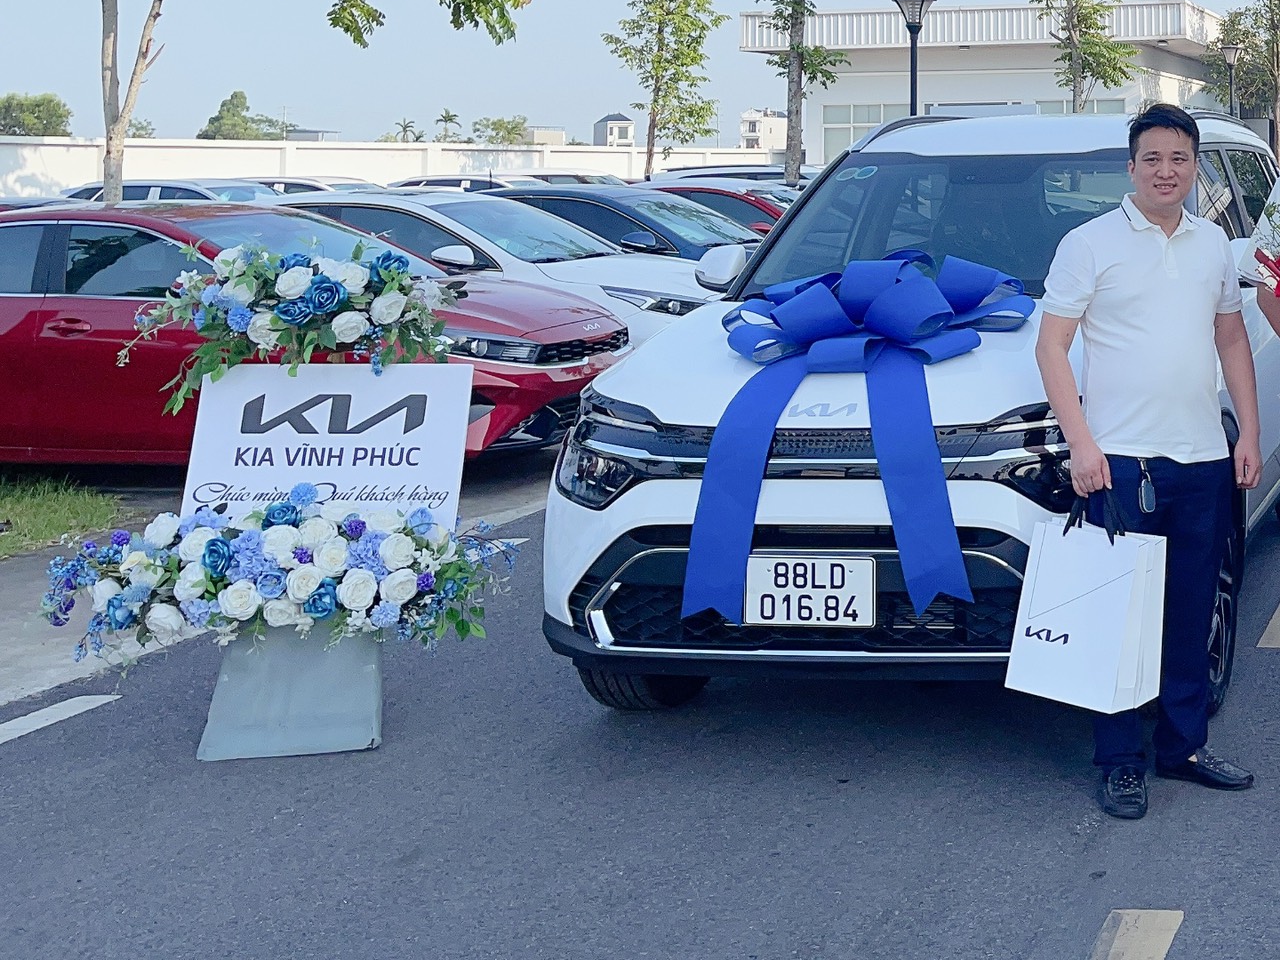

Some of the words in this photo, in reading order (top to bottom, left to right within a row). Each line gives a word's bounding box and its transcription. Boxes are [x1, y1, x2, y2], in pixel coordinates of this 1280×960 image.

[240, 393, 428, 435] KIA
[787, 403, 858, 417] KIA
[234, 446, 274, 467] KIA
[284, 443, 344, 467] VĨNH
[352, 442, 421, 467] PHÚC
[192, 482, 252, 503] Chúc
[354, 485, 405, 501] khách
[407, 485, 449, 509] hàng
[773, 562, 846, 589] 88LD
[760, 593, 859, 622] 016.84
[1025, 625, 1069, 645] KIA
